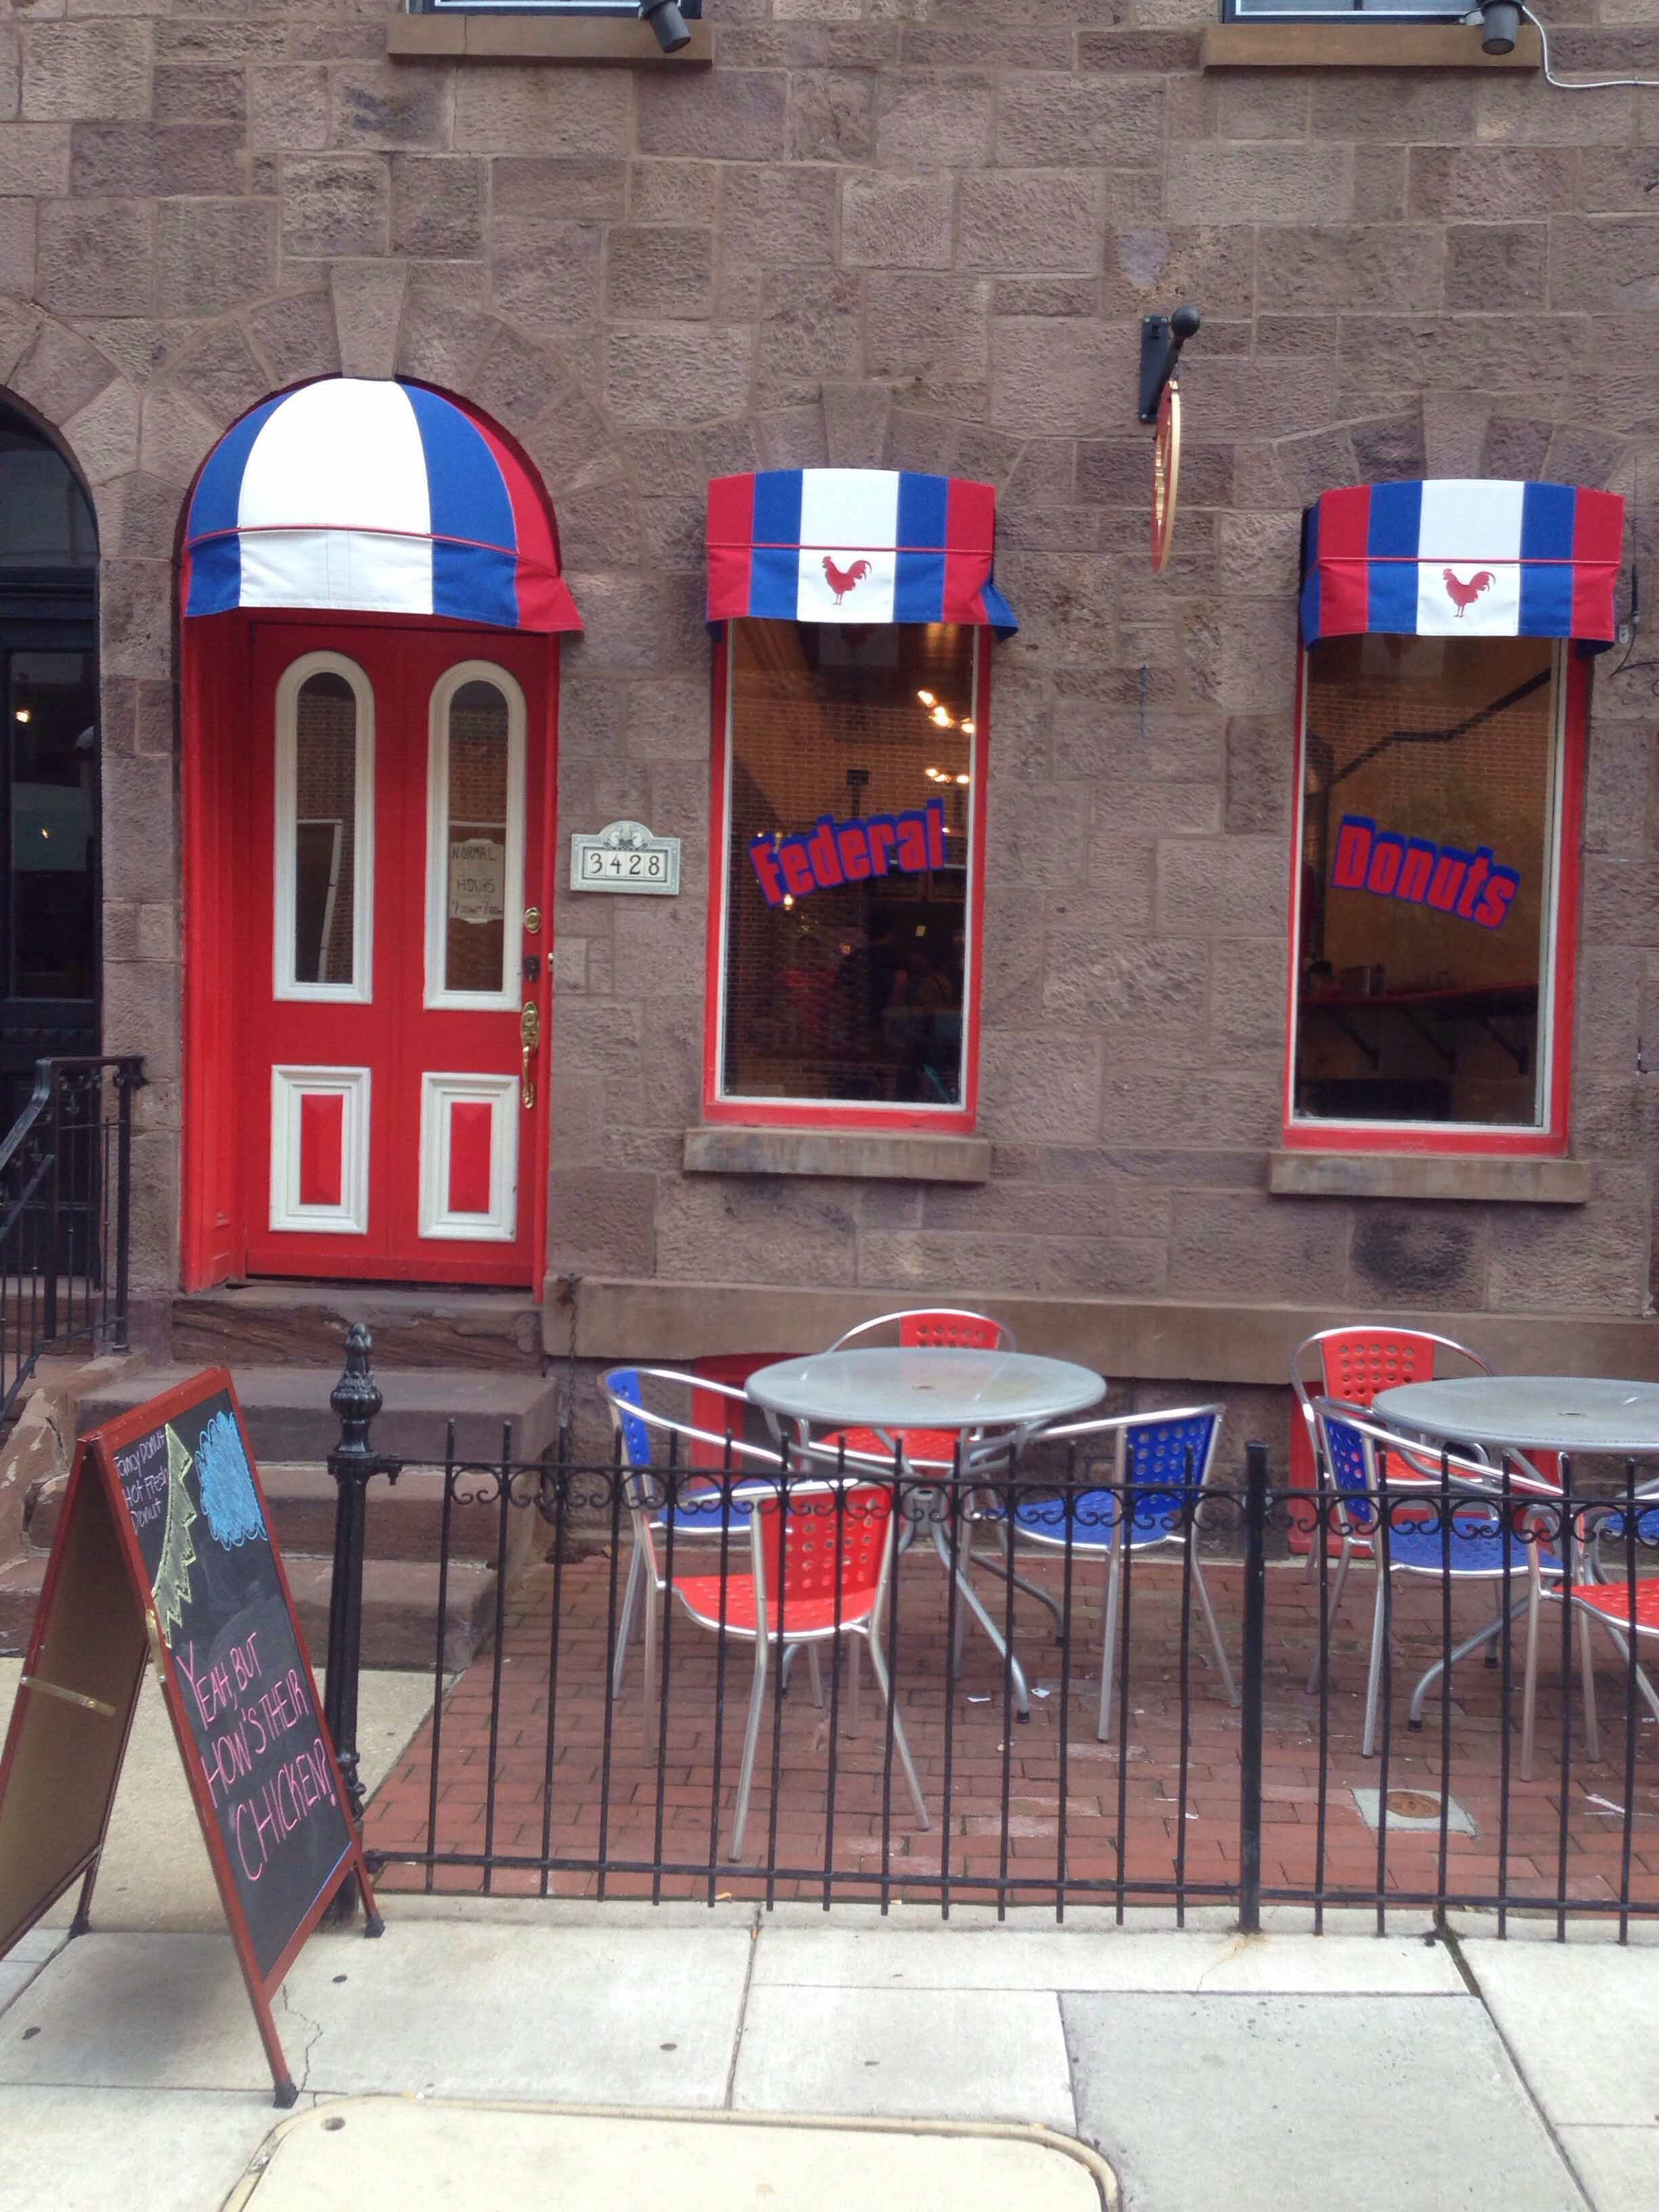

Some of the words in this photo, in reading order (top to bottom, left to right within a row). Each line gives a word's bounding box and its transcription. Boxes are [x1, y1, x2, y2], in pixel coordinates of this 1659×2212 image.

[590, 853, 660, 876] 3428
[748, 798, 947, 911] Federal
[1330, 814, 1521, 930] Donuts
[176, 1640, 237, 1730] YEAH,
[230, 1632, 262, 1692] BUT
[201, 1706, 266, 1809] HOW'S
[260, 1668, 308, 1740] THEIR
[236, 1738, 336, 1881] CHICKEN?
